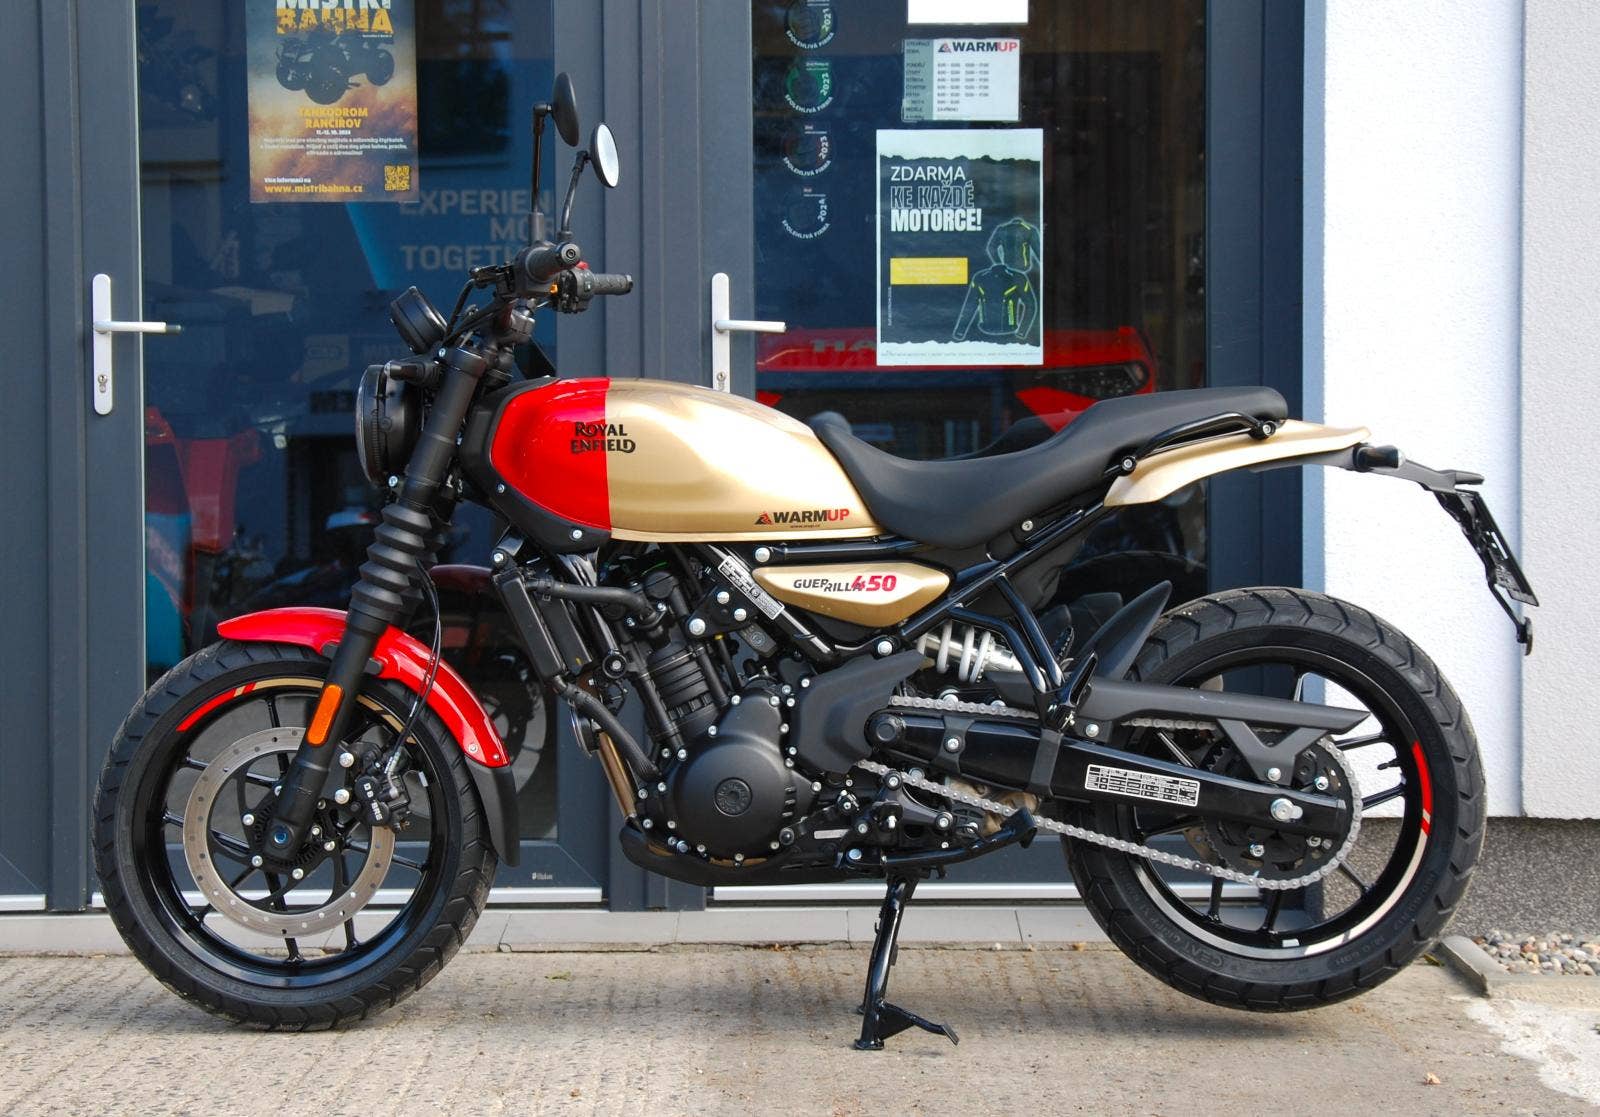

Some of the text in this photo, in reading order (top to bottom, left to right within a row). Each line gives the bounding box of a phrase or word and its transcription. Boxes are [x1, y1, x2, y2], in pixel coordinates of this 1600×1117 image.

[952, 41, 1018, 53] WARMUP
[819, 135, 829, 159] 2023
[891, 166, 966, 181] ZDARMA
[891, 180, 975, 210] KE KAŽDÉ
[891, 208, 982, 232] MOTORCE!
[575, 421, 628, 437] ROYAL
[571, 439, 636, 454] ENFIELD
[773, 508, 850, 524] WARMUP
[852, 575, 897, 593] 450
